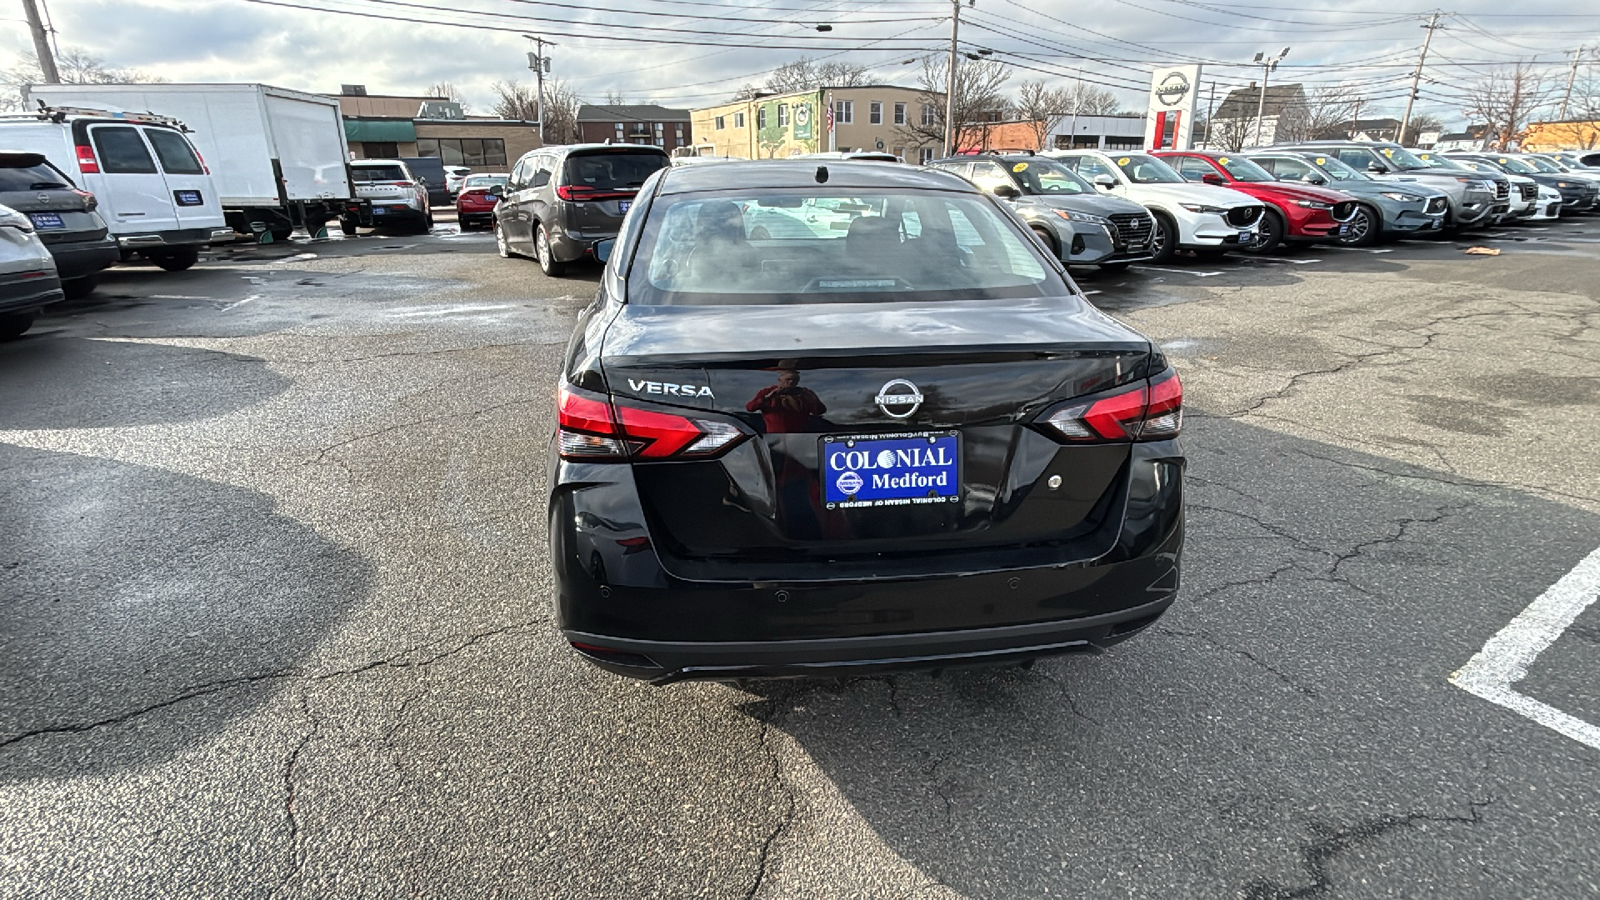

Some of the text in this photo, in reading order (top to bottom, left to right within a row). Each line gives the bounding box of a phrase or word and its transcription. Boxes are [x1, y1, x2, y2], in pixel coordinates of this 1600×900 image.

[1155, 84, 1189, 95] NISSAN
[627, 378, 716, 400] VERSA
[875, 395, 923, 404] NISSAN
[830, 447, 953, 471] COLONIAL
[872, 471, 948, 489] Medford
[839, 501, 873, 509] MEDFORD
[885, 498, 911, 506] NISSAN
[912, 496, 946, 504] COLONIAL
